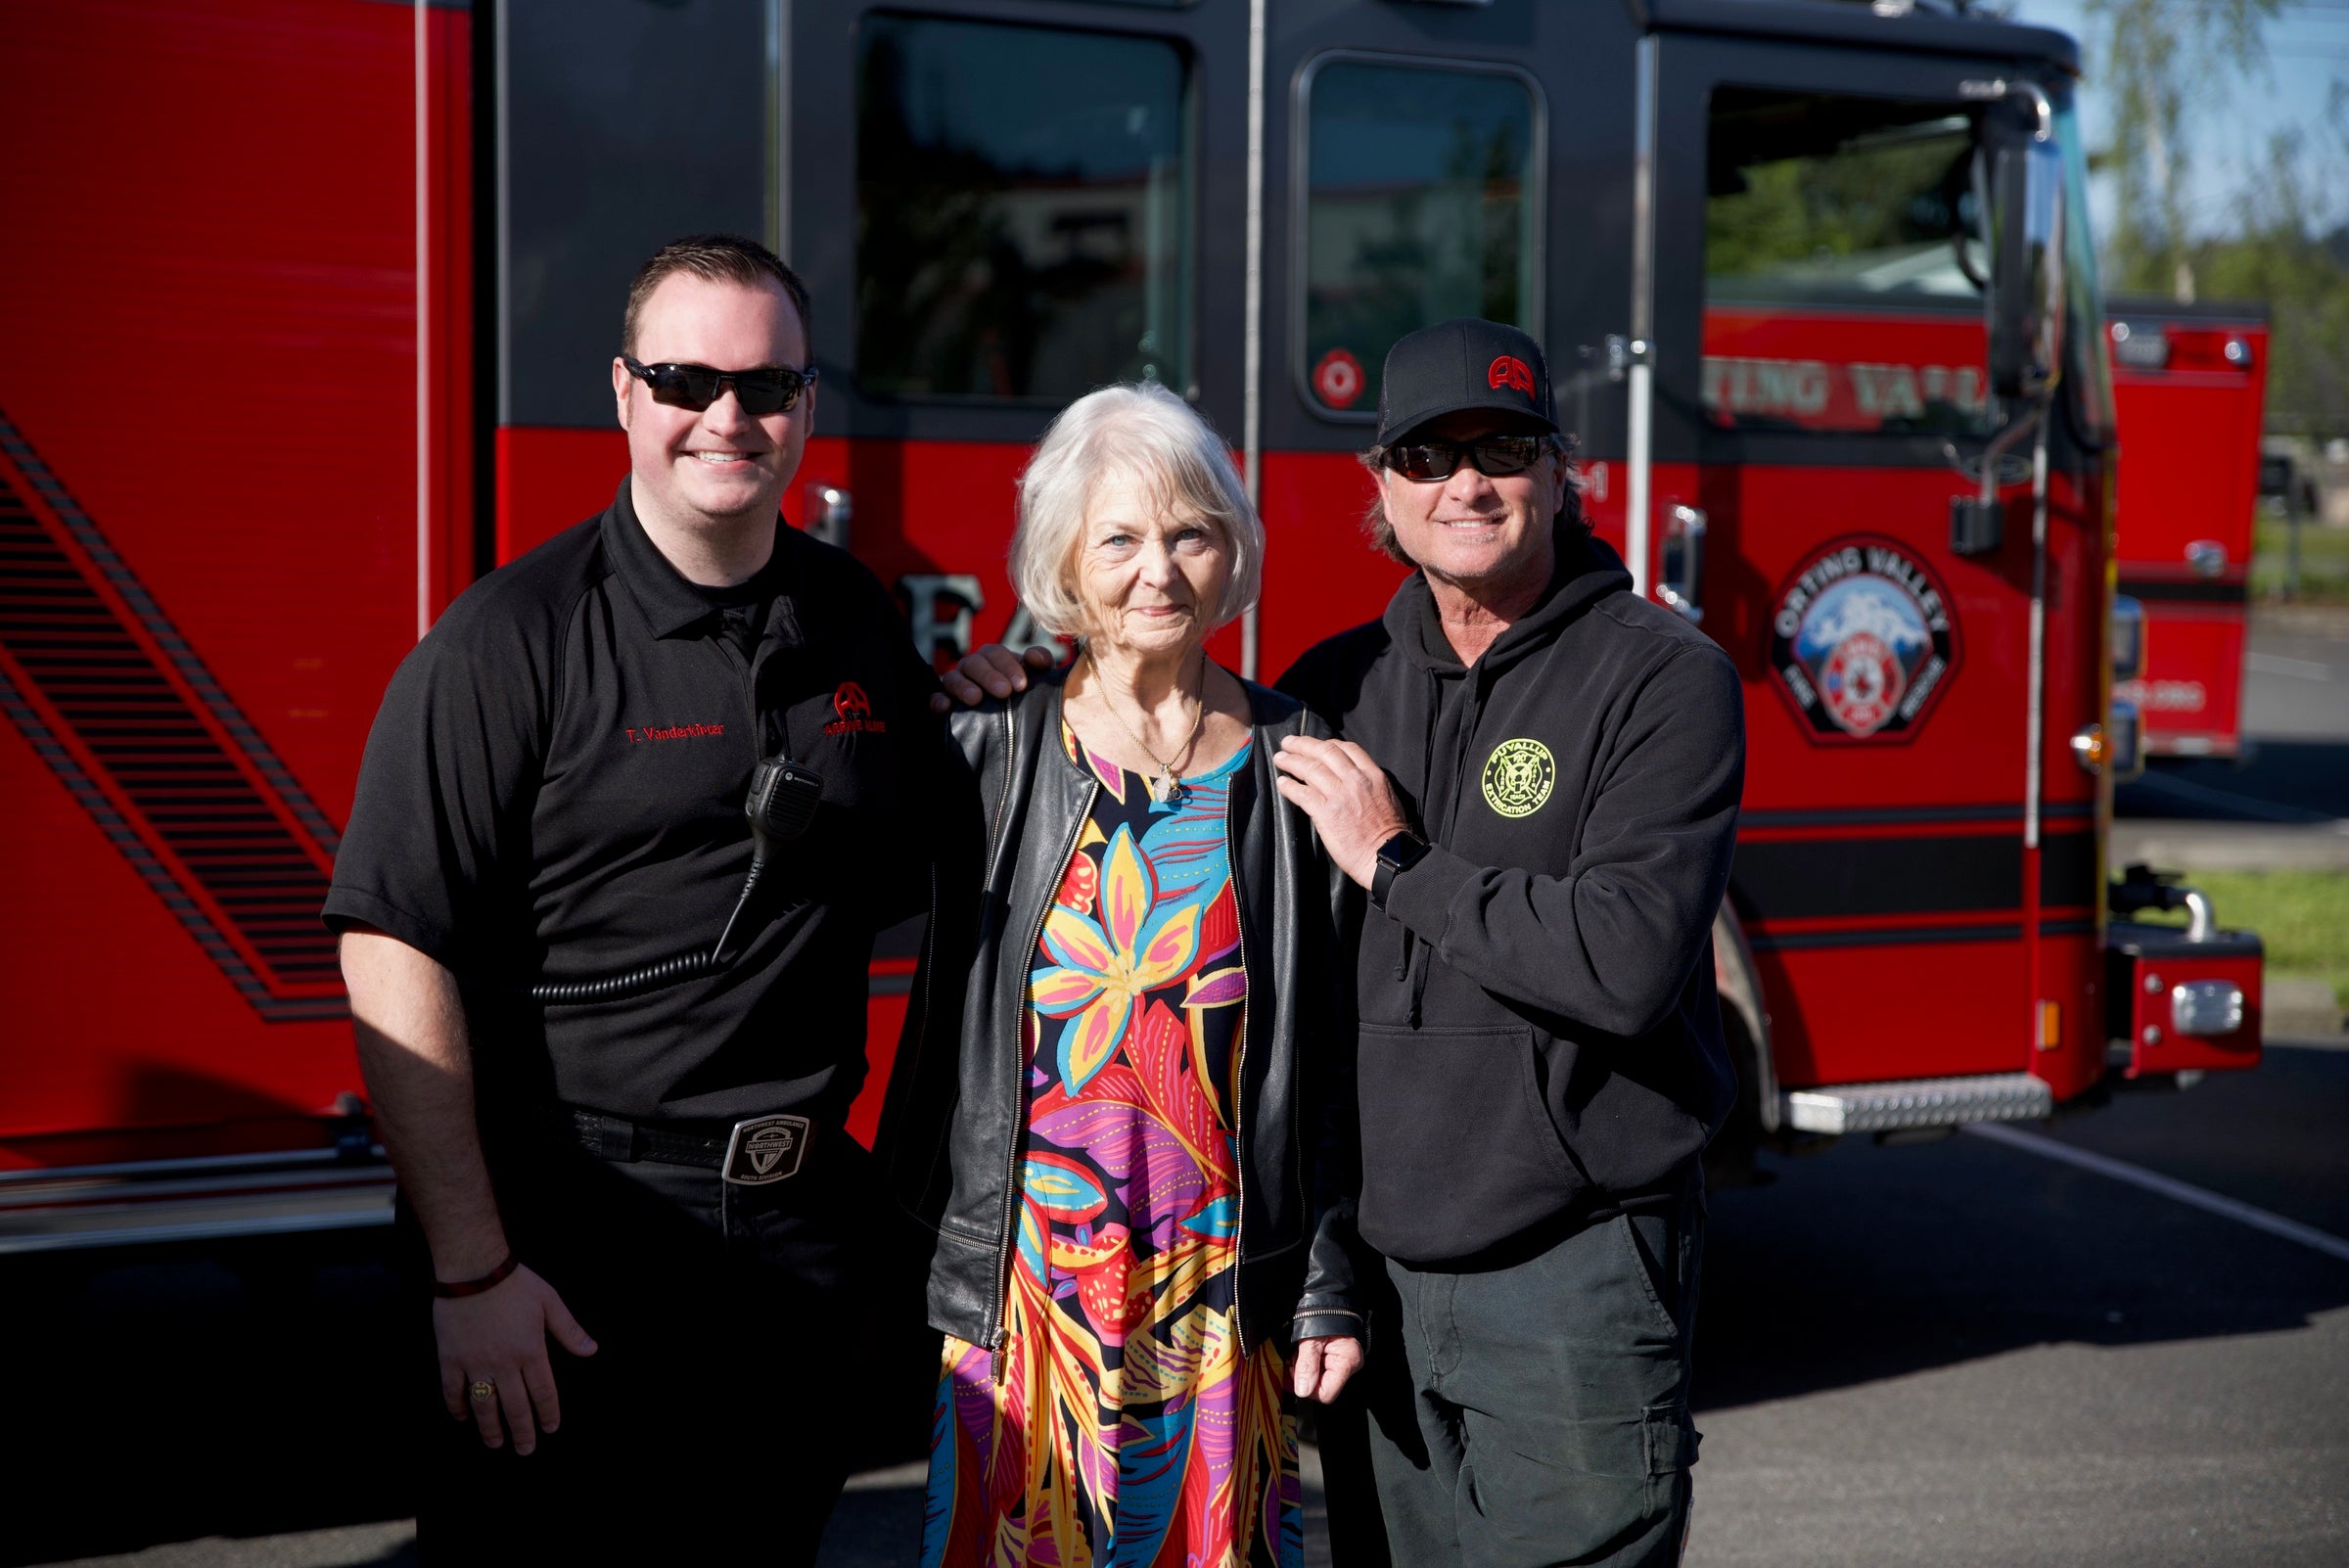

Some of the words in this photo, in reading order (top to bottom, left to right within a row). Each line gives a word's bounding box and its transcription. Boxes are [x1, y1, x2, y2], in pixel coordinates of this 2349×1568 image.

[1774, 546, 1863, 638] ORTING
[1865, 546, 1951, 632] VALLEY
[625, 728, 642, 743] T.
[1491, 743, 1547, 763] PUYALLUP
[1486, 783, 1532, 813] EXTRICATION
[1532, 779, 1551, 805] TEAM
[743, 1121, 775, 1132] NORTHWEST
[775, 1120, 805, 1129] AMBULANCE
[748, 1140, 790, 1150] NORTHWEST
